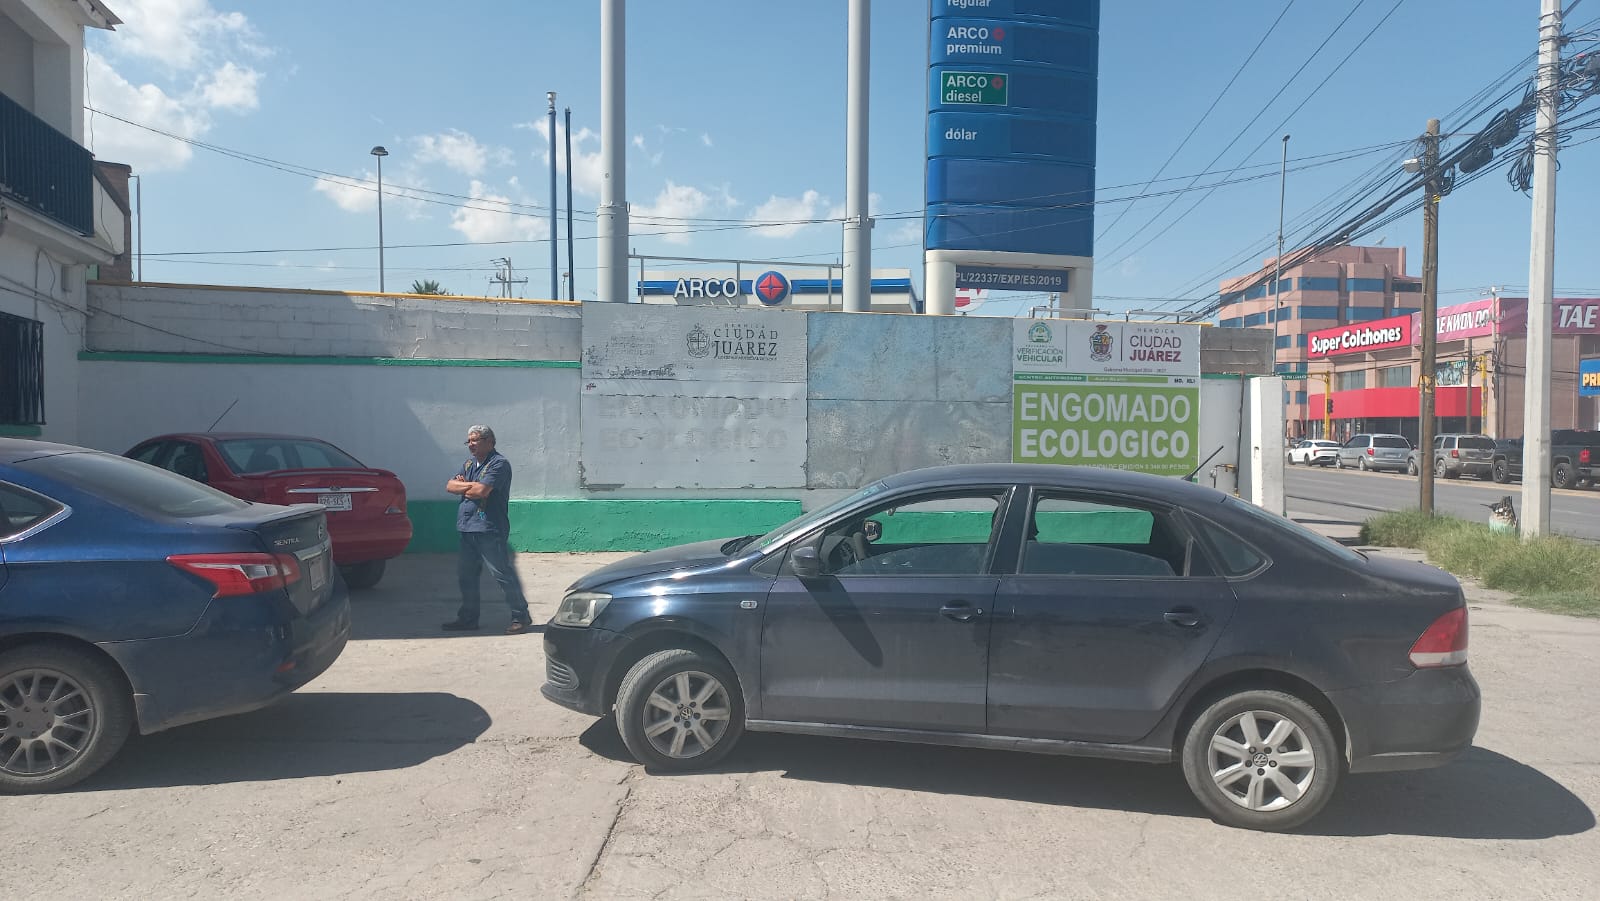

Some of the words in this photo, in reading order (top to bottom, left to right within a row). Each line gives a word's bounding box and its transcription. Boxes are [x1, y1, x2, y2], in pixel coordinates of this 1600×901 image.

[947, 27, 989, 40] ARCO
[946, 42, 1002, 56] premium
[946, 75, 988, 88] ARCO
[945, 90, 982, 103] diesel
[945, 128, 977, 141] dólar
[673, 278, 739, 299] ARCO
[1446, 311, 1474, 333] KWON
[1559, 304, 1599, 329] TAE
[713, 328, 779, 340] CIUDAD
[1311, 336, 1341, 354] Super
[1341, 327, 1401, 349] Colchones
[713, 337, 778, 359] JUÁREZ
[1129, 335, 1182, 349] CIUDAD
[1016, 354, 1063, 363] VEHICULAR
[1129, 347, 1182, 363] JUÁREZ
[1020, 391, 1191, 424] ENGOMADO
[1020, 428, 1190, 459] ECOLOGICO
